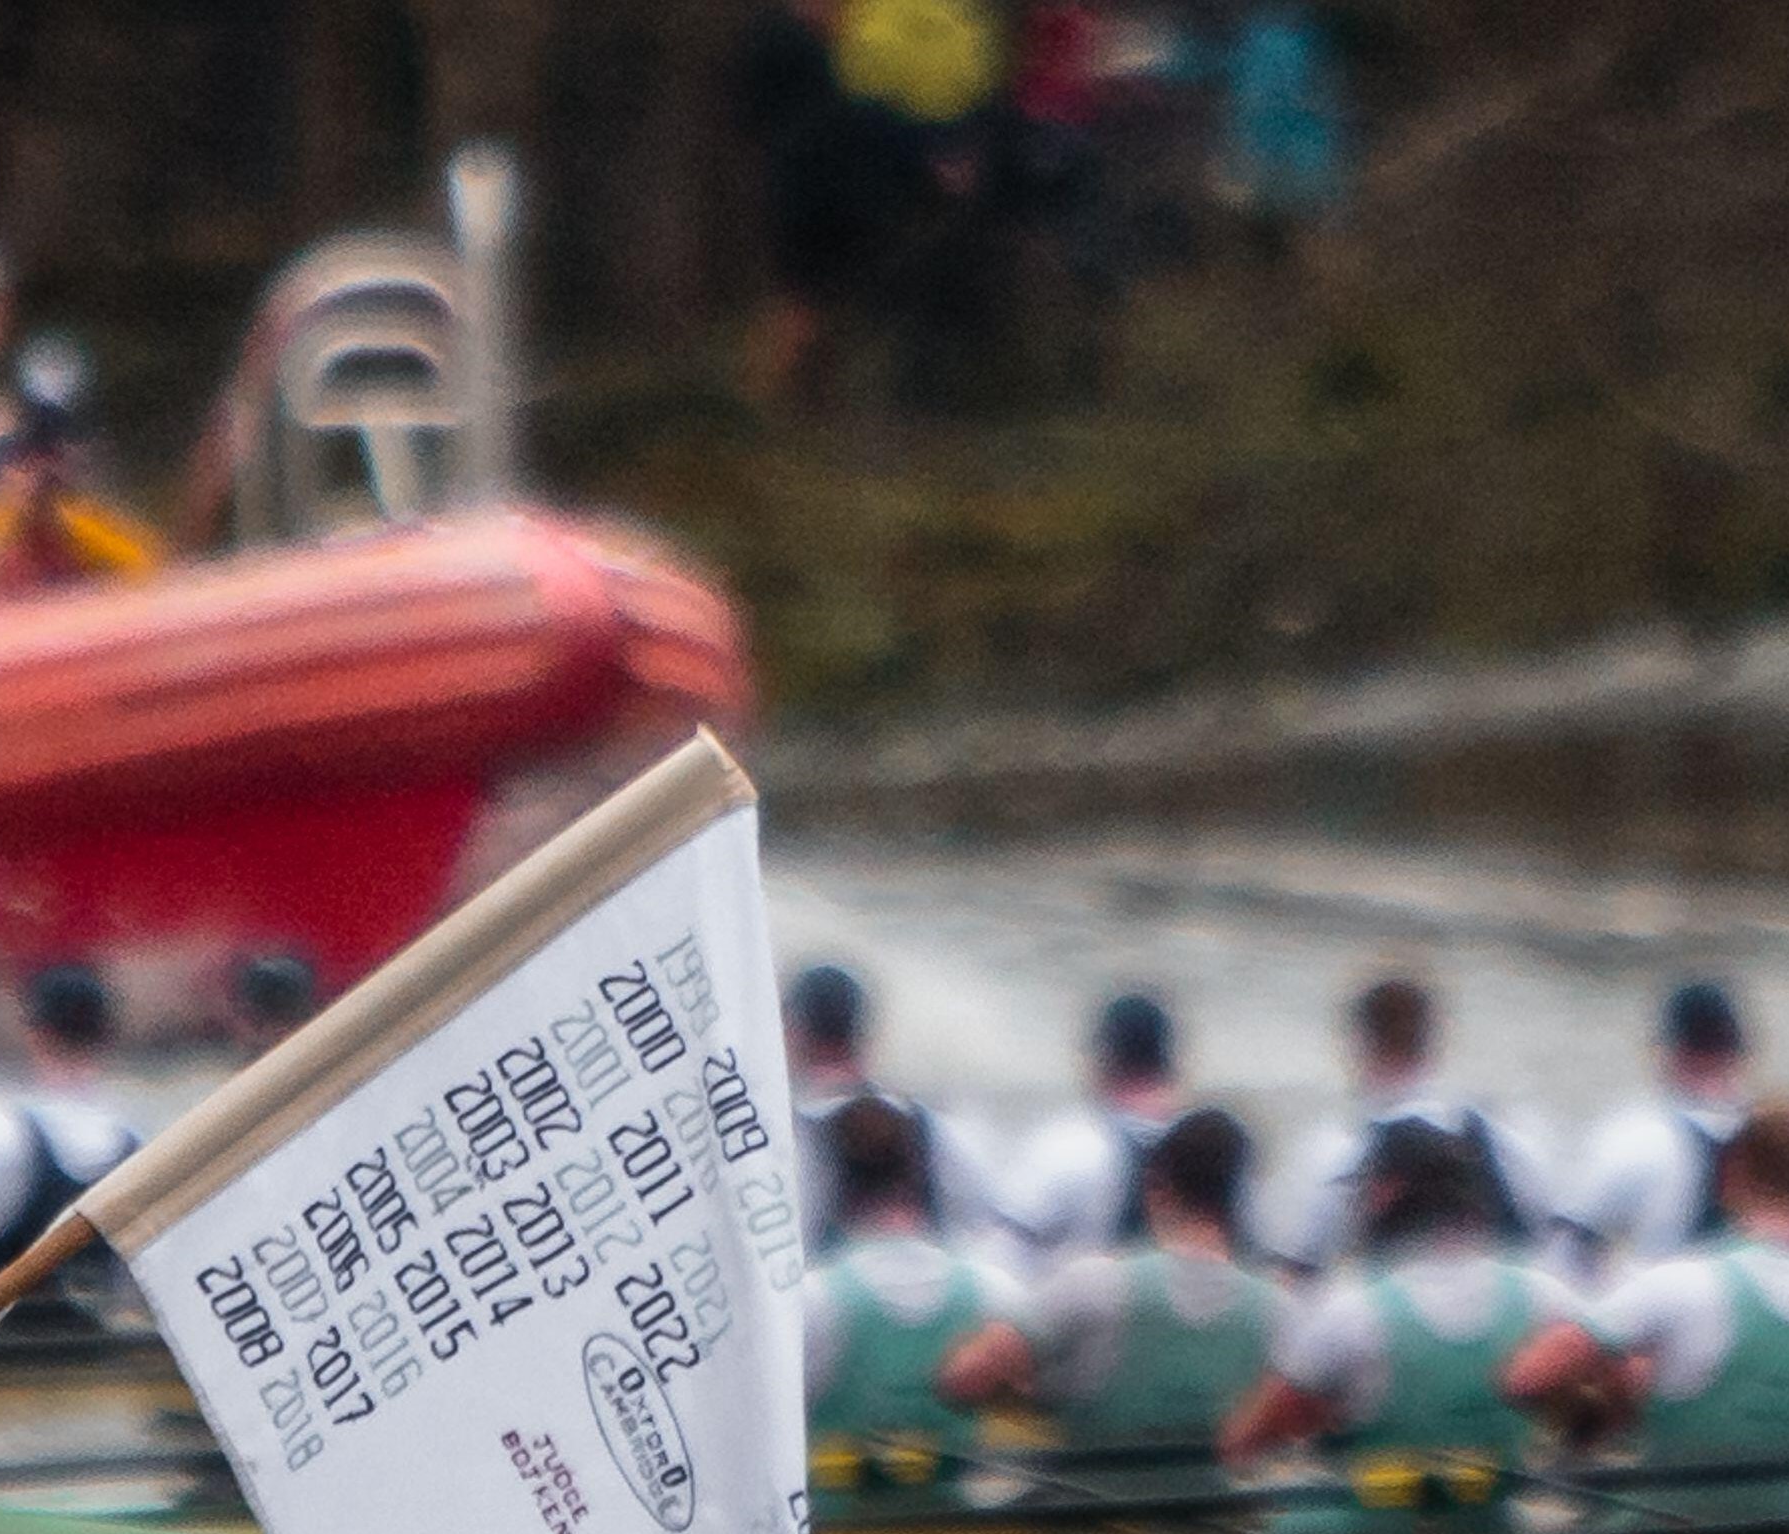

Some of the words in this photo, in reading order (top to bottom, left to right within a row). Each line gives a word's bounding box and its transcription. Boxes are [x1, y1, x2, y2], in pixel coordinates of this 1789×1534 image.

[550, 998, 631, 1110] 2001
[599, 960, 686, 1073] 2000
[444, 1071, 530, 1180] 2003
[497, 1037, 581, 1150] 2002
[703, 1046, 769, 1163] 2009
[345, 1147, 419, 1255] 2005
[395, 1107, 473, 1215] 2004
[555, 1150, 642, 1264] 2012
[608, 1109, 693, 1227] 2011
[253, 1224, 328, 1323] 2007
[302, 1187, 369, 1294] 2006
[445, 1214, 533, 1326] 2014
[503, 1182, 589, 1298] 2013
[196, 1255, 284, 1368] 2008
[348, 1290, 423, 1398] 2016
[394, 1250, 478, 1362] 2015
[615, 1262, 700, 1384] 2022
[261, 1369, 324, 1472] 2018
[308, 1326, 376, 1425] 2017
